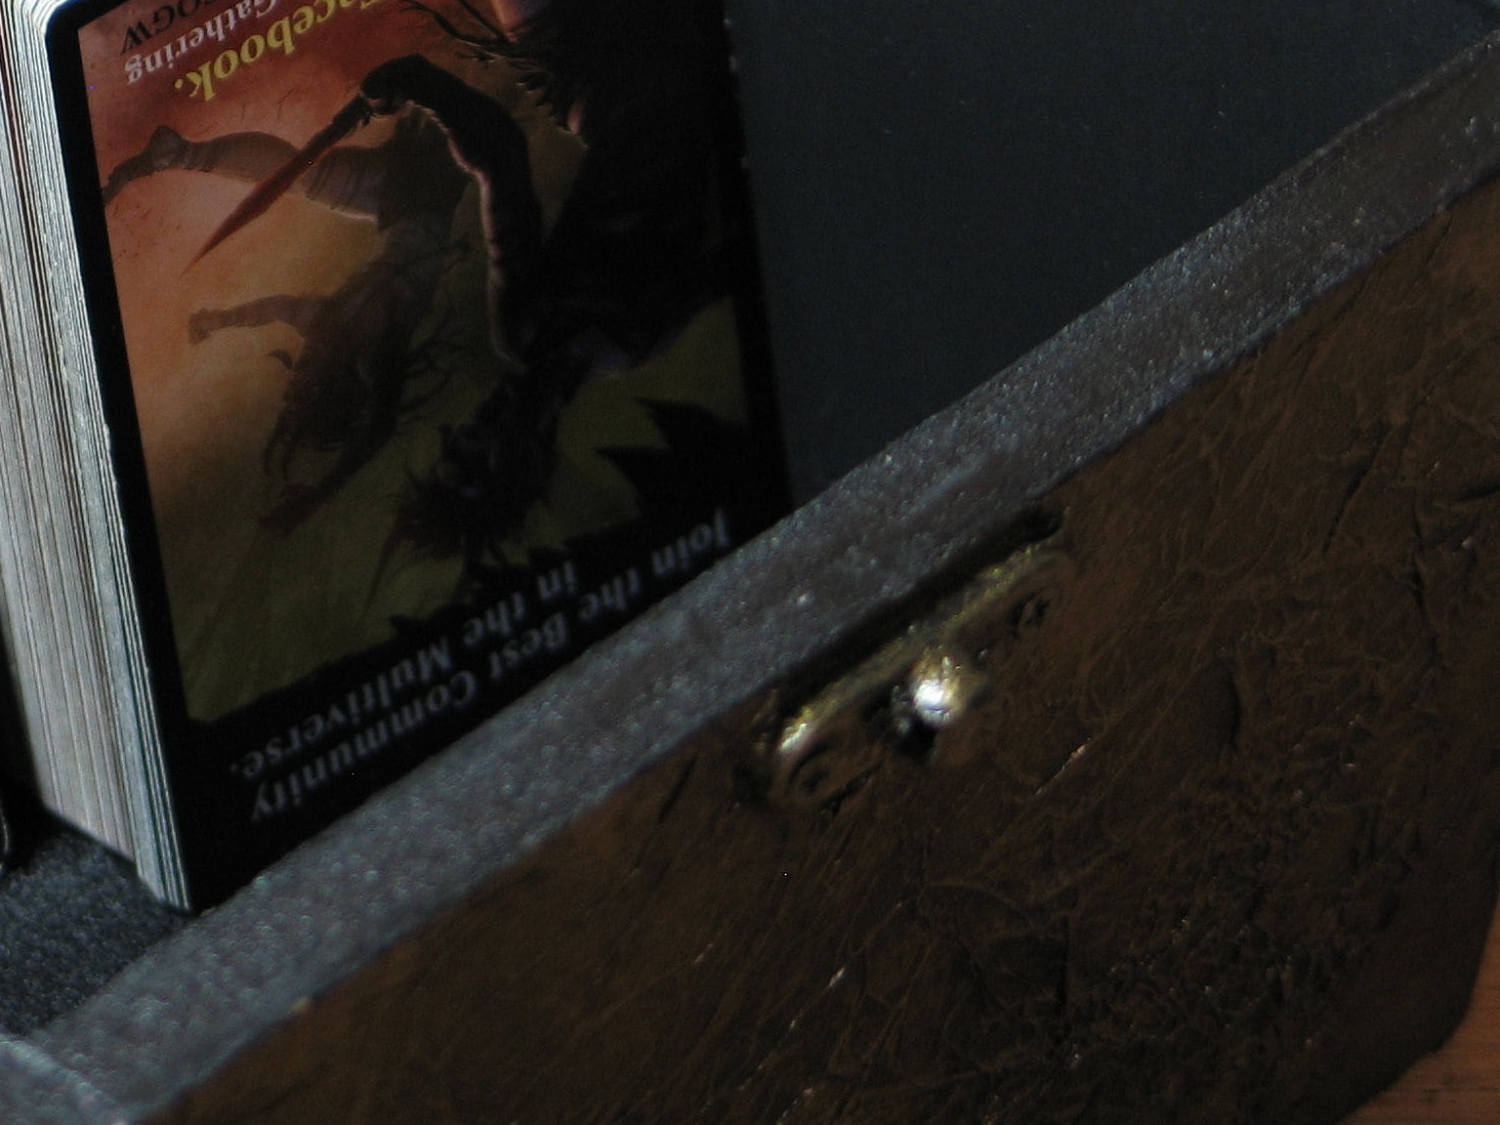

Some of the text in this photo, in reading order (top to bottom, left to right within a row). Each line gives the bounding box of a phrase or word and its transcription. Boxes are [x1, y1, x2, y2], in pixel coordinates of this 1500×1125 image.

[230, 560, 576, 778] in the Multiverse.
[252, 510, 729, 820] Join the Best Community
